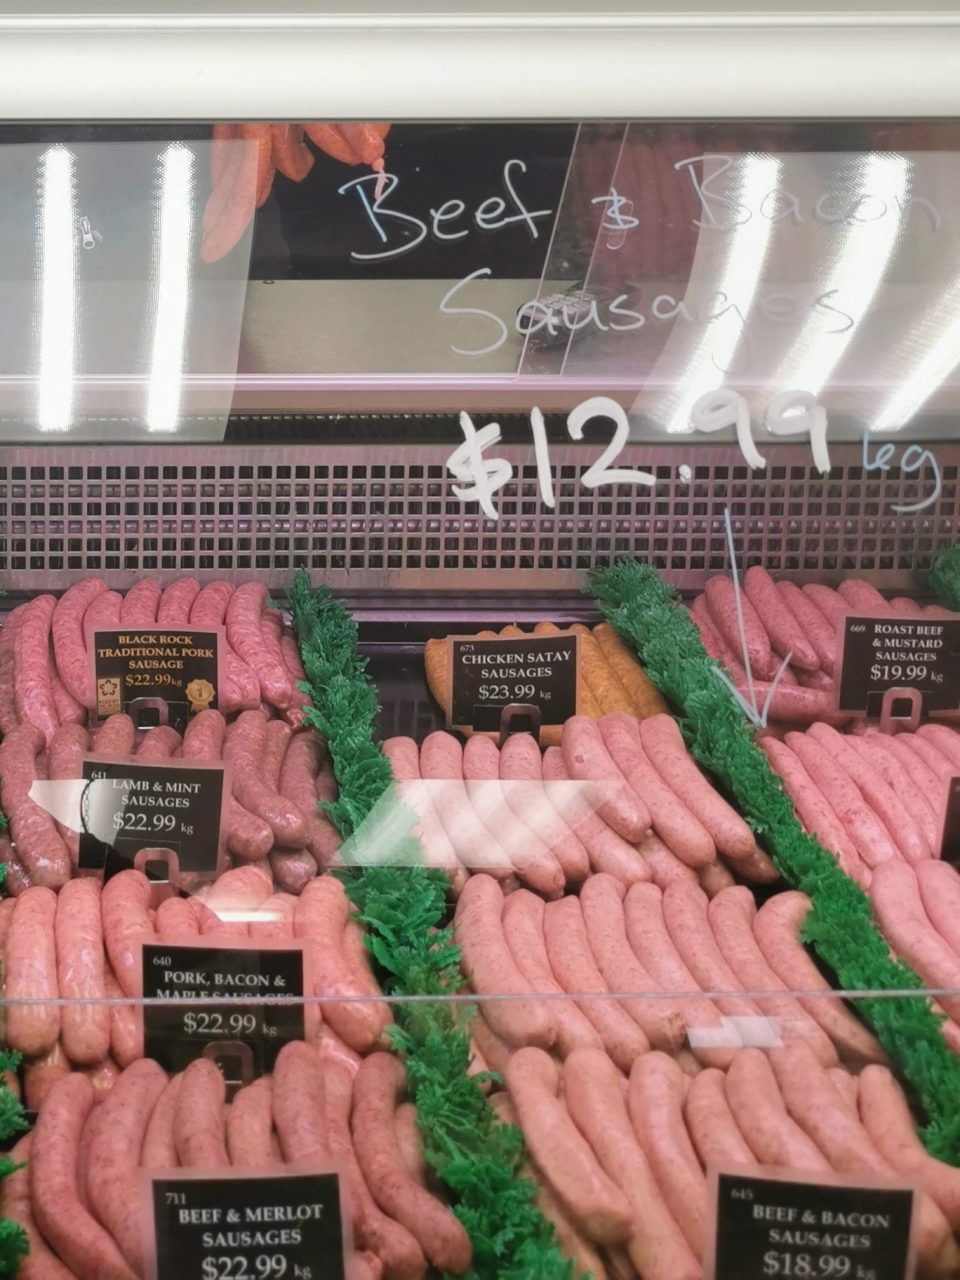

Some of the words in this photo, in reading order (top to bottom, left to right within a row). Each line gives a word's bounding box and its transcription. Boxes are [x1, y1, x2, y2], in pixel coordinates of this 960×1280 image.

[339, 159, 553, 260] Beef
[674, 154, 939, 233] Bacon
[440, 268, 854, 374] Sausages
[446, 390, 831, 520] $12.99
[850, 624, 866, 633] 669
[874, 624, 915, 635] ROAST
[916, 625, 944, 636] BEEF
[118, 635, 157, 644] BLACK
[160, 635, 193, 645] ROCK
[872, 638, 881, 647] &
[884, 638, 943, 649] MUSTARD
[97, 647, 179, 658] TRADITIONAL
[181, 648, 214, 658] PORK
[462, 654, 524, 665] CHICKEN
[527, 650, 571, 663] SATAY
[875, 651, 937, 662] SAUSAGES
[129, 660, 184, 669] SAUSAGE
[481, 667, 552, 679] SAUSAGES
[870, 664, 927, 681] $19.99
[930, 671, 944, 684] kg
[478, 684, 535, 701] $23.99
[540, 690, 552, 700] kg
[91, 771, 107, 780] 641
[113, 780, 150, 791] LAMB
[153, 781, 163, 792] &
[165, 782, 202, 794] MINT
[121, 795, 190, 808] SAUSAGES
[112, 811, 176, 832] $22.99
[181, 822, 194, 835] kg
[153, 956, 171, 966] 640
[164, 970, 210, 986] PORK,
[214, 974, 269, 987] BACON
[274, 975, 286, 987] &
[183, 1012, 257, 1035] $22.99
[262, 1024, 277, 1037] kg
[165, 1192, 186, 1205] 711
[731, 1188, 753, 1200] 645
[178, 1208, 222, 1224] BEEF
[226, 1208, 241, 1223] &
[245, 1204, 324, 1222] MERLOT
[752, 1204, 797, 1222] BEEF
[801, 1209, 816, 1224] &
[821, 1211, 889, 1228] BACON
[202, 1229, 302, 1247] SAUSAGES
[768, 1228, 871, 1248] SAUSAGES
[201, 1254, 287, 1280] $22.99
[294, 1263, 312, 1280] kg
[763, 1250, 851, 1277] $18.99
